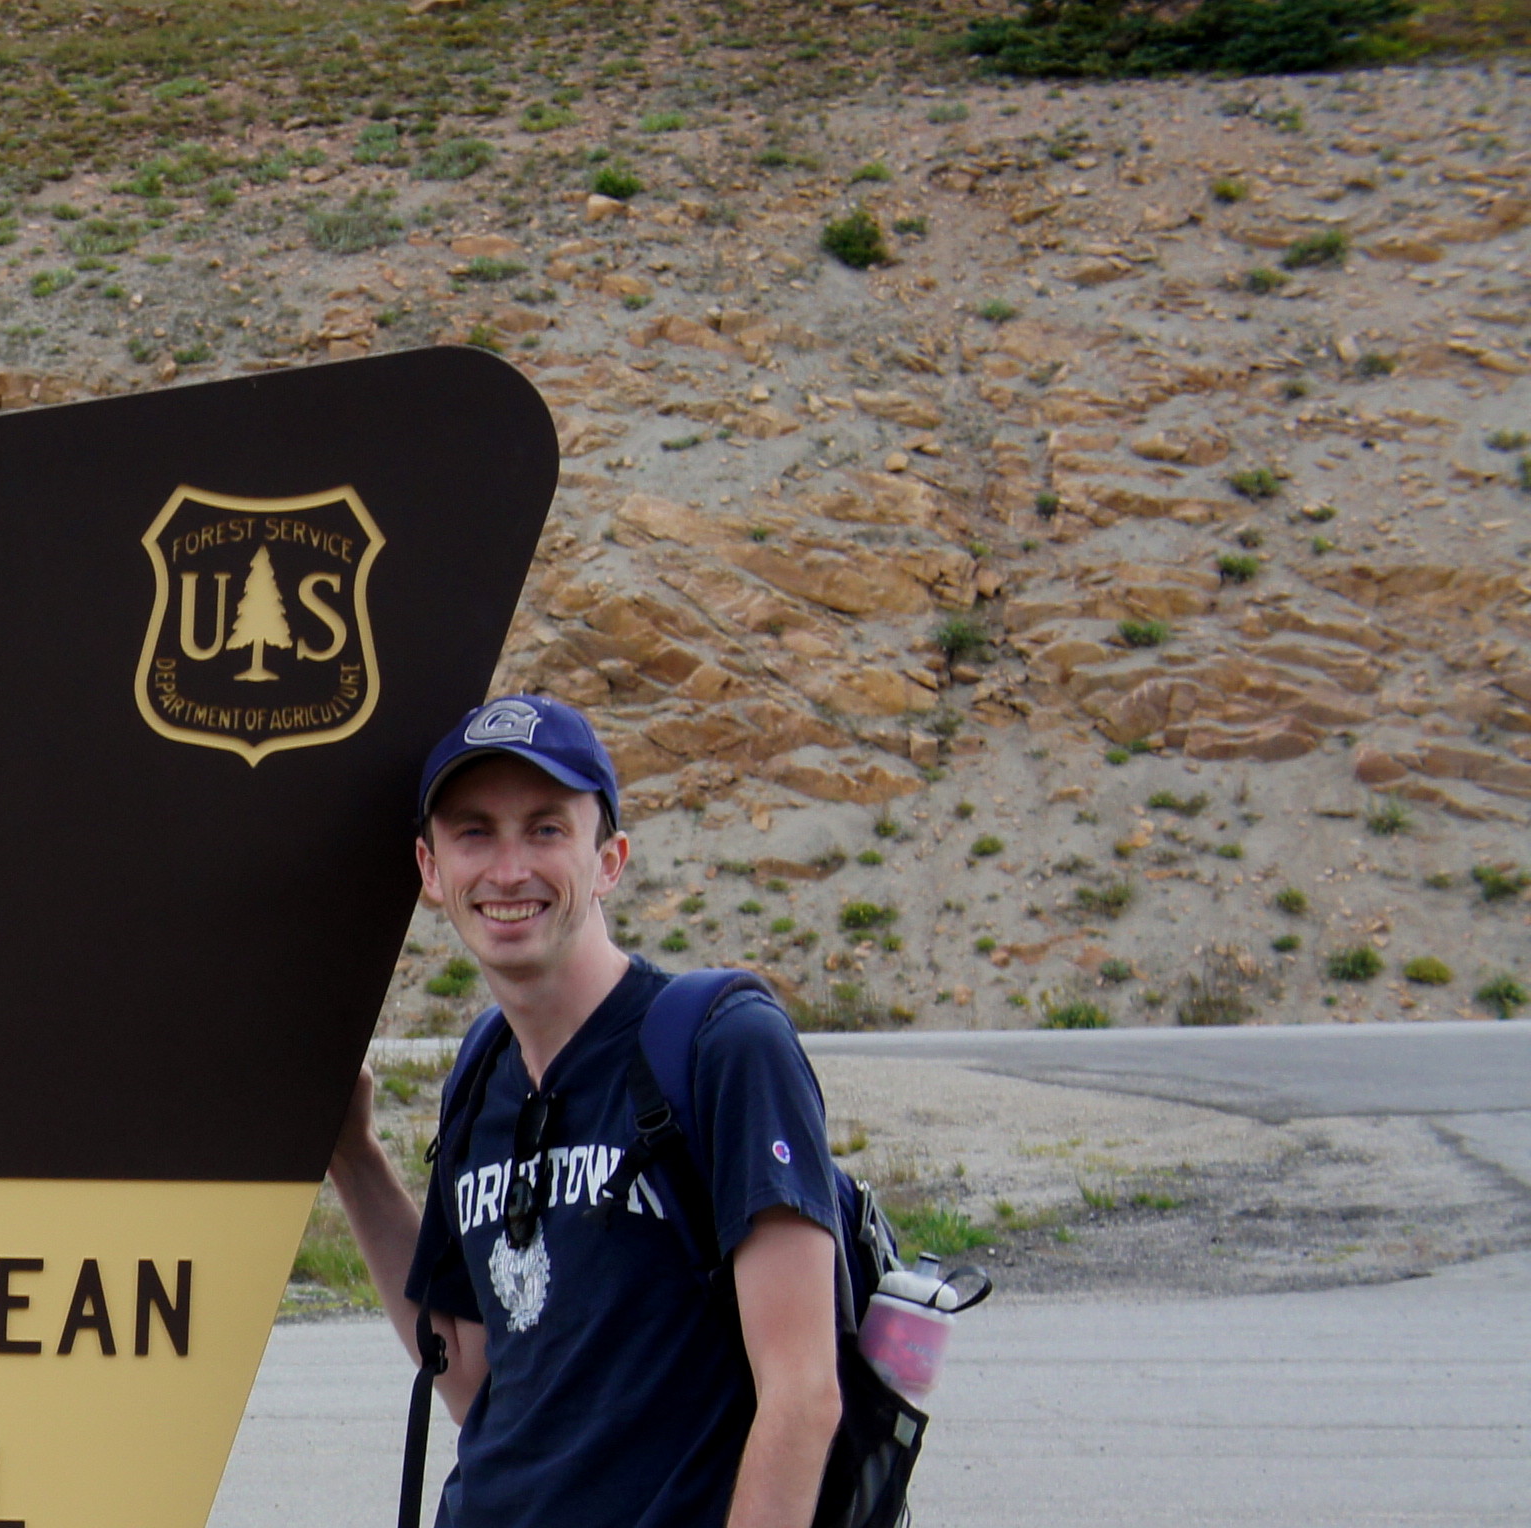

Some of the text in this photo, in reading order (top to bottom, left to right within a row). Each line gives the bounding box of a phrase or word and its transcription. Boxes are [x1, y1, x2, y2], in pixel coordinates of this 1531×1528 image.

[172, 517, 354, 564] FOREST SERVICE
[154, 657, 362, 731] DEPARTMENT OF AGRICULTURE
